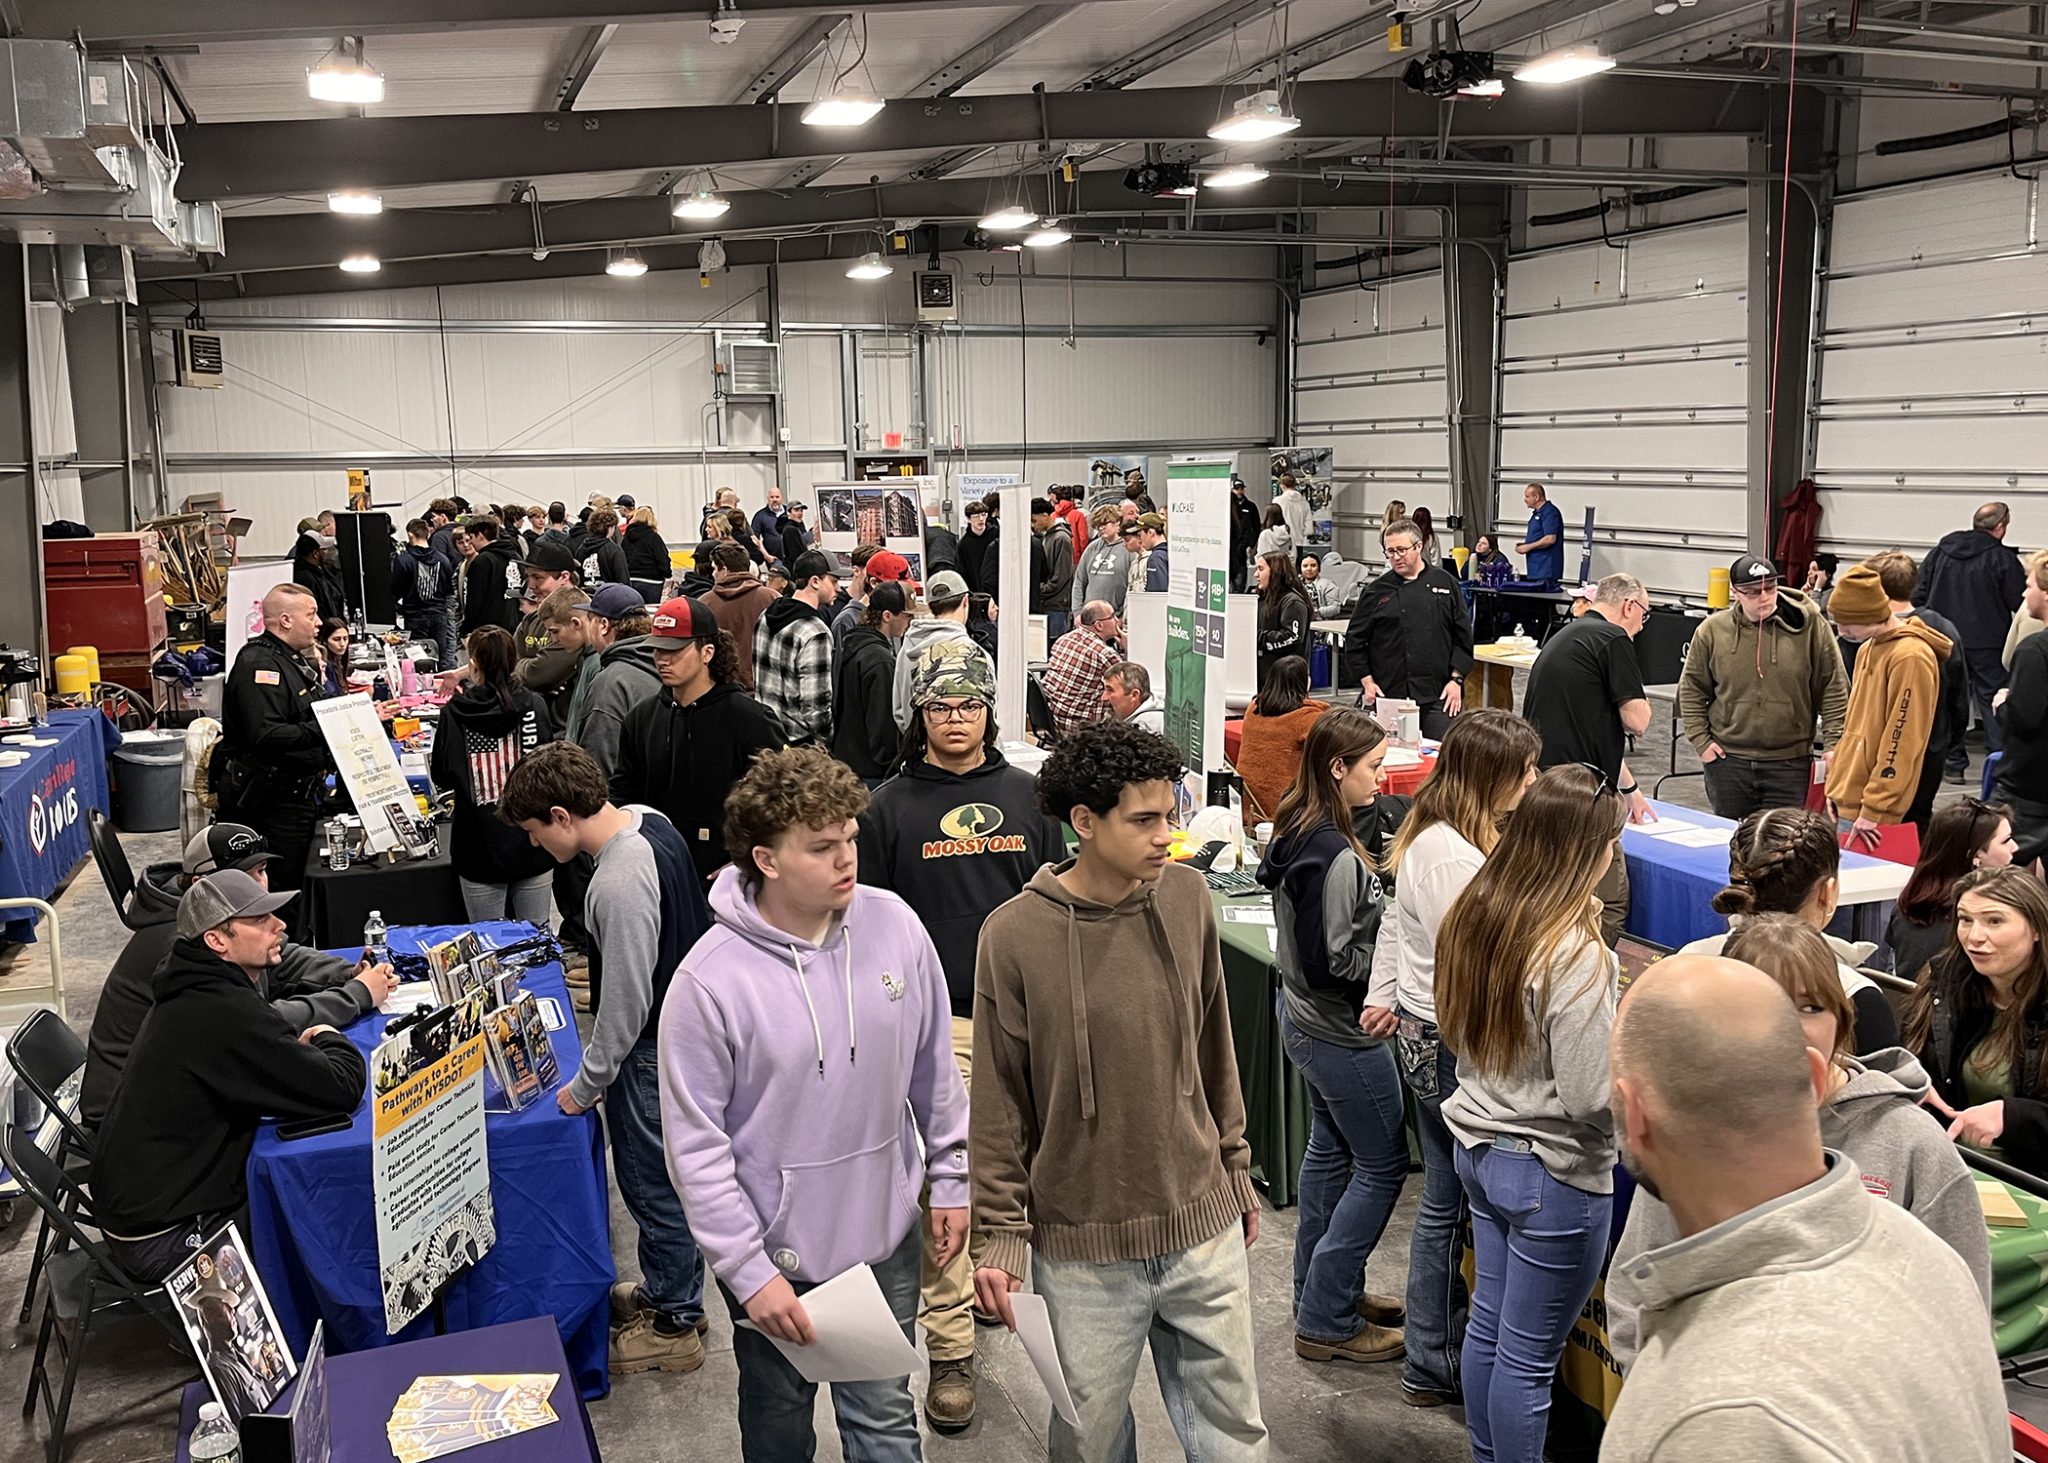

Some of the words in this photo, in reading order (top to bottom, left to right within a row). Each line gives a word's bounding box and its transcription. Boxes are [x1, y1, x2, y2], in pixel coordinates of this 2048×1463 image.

[960, 486, 985, 495] Variety
[963, 477, 998, 486] Exposure
[1886, 688, 1912, 765] carhartt
[923, 837, 990, 859] MOSSY
[988, 835, 1027, 853] OAK
[382, 1076, 430, 1114] Pathways
[431, 1069, 442, 1081] to
[443, 1065, 449, 1073] a
[450, 1042, 480, 1067] Career
[401, 1095, 423, 1117] with
[424, 1065, 464, 1102] NYSDOT
[387, 1135, 398, 1148] Job
[398, 1115, 427, 1139] shadowing
[427, 1109, 435, 1118] for
[436, 1097, 453, 1112] Career
[453, 1079, 476, 1100] Technical
[387, 1132, 415, 1156] Education
[415, 1119, 433, 1138] juniors
[387, 1158, 401, 1174] Paid
[401, 1149, 415, 1163] work
[416, 1138, 431, 1153] study
[431, 1132, 439, 1141] for
[440, 1120, 456, 1135] Career
[457, 1101, 479, 1122] Technical
[388, 1158, 416, 1182] Education
[417, 1144, 436, 1161] seniors
[389, 1184, 402, 1199] Paid
[403, 1163, 433, 1189] internships
[433, 1157, 441, 1167] for
[441, 1143, 459, 1160] college
[459, 1127, 480, 1146] students
[390, 1194, 410, 1212] Career
[410, 1166, 446, 1198] opportunities
[446, 1160, 454, 1169] for
[454, 1146, 472, 1163] college
[391, 1196, 419, 1224] graduates
[420, 1186, 432, 1199] with
[433, 1163, 461, 1190] automotive
[391, 1204, 422, 1232] agriculture
[423, 1193, 434, 1207] and
[434, 1172, 462, 1198] technology
[462, 1157, 481, 1176] degrees
[172, 1264, 199, 1294] SERVE
